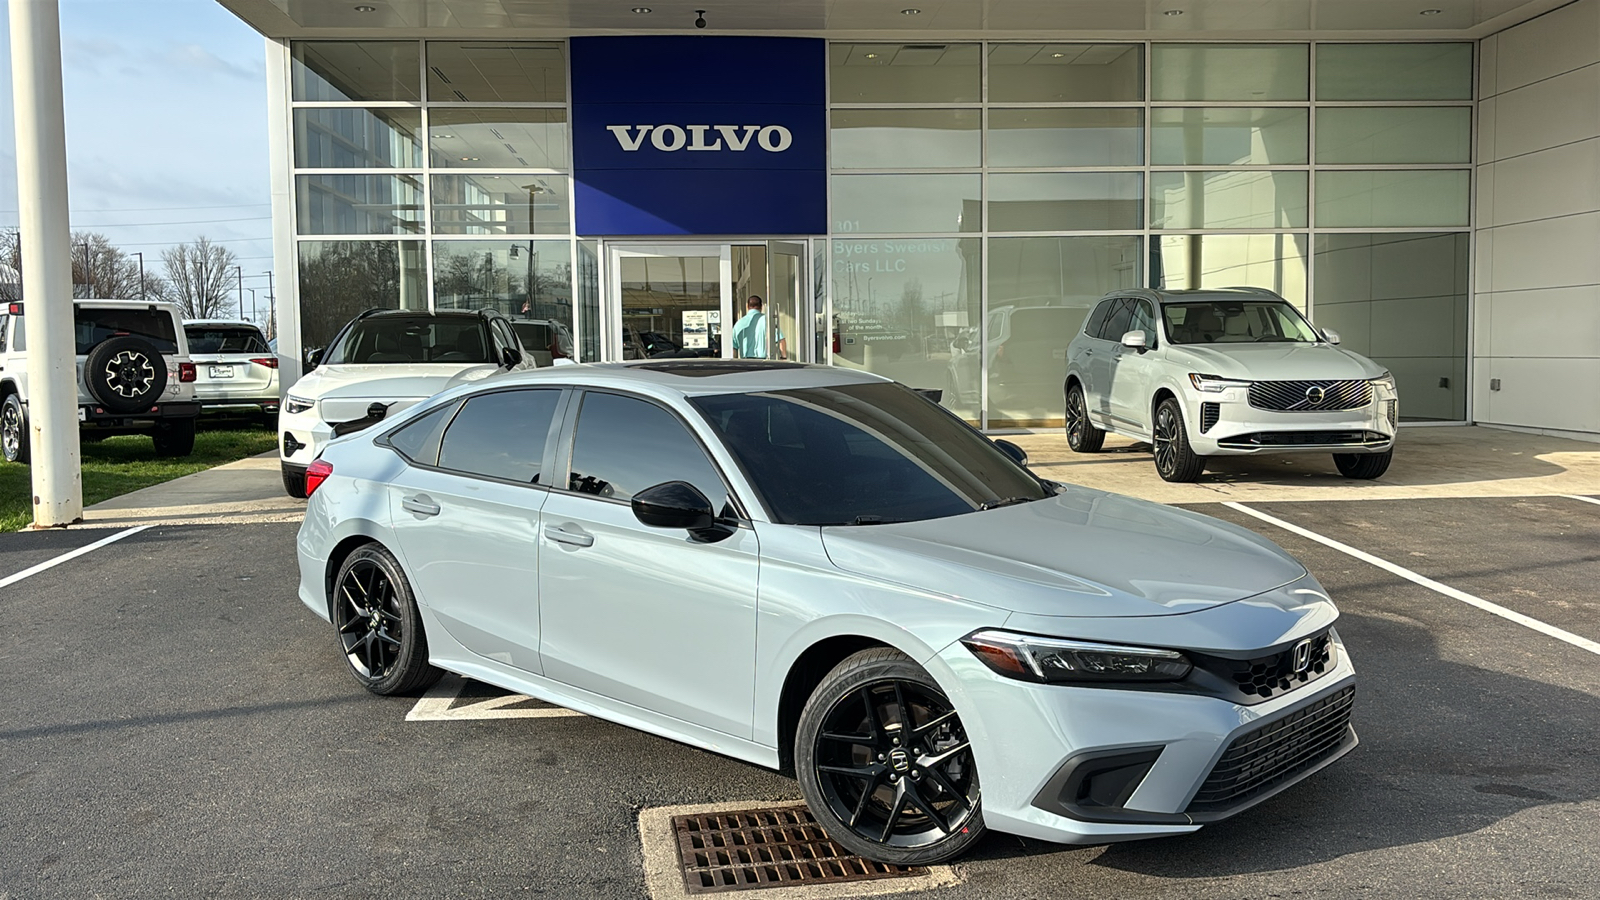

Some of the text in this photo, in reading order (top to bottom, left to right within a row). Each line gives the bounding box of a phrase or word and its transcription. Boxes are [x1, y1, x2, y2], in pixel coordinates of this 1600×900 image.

[606, 124, 793, 152] VOLVO
[835, 220, 859, 232] 301
[834, 241, 949, 257] Byers Swedish
[834, 258, 906, 272] Cars LLC
